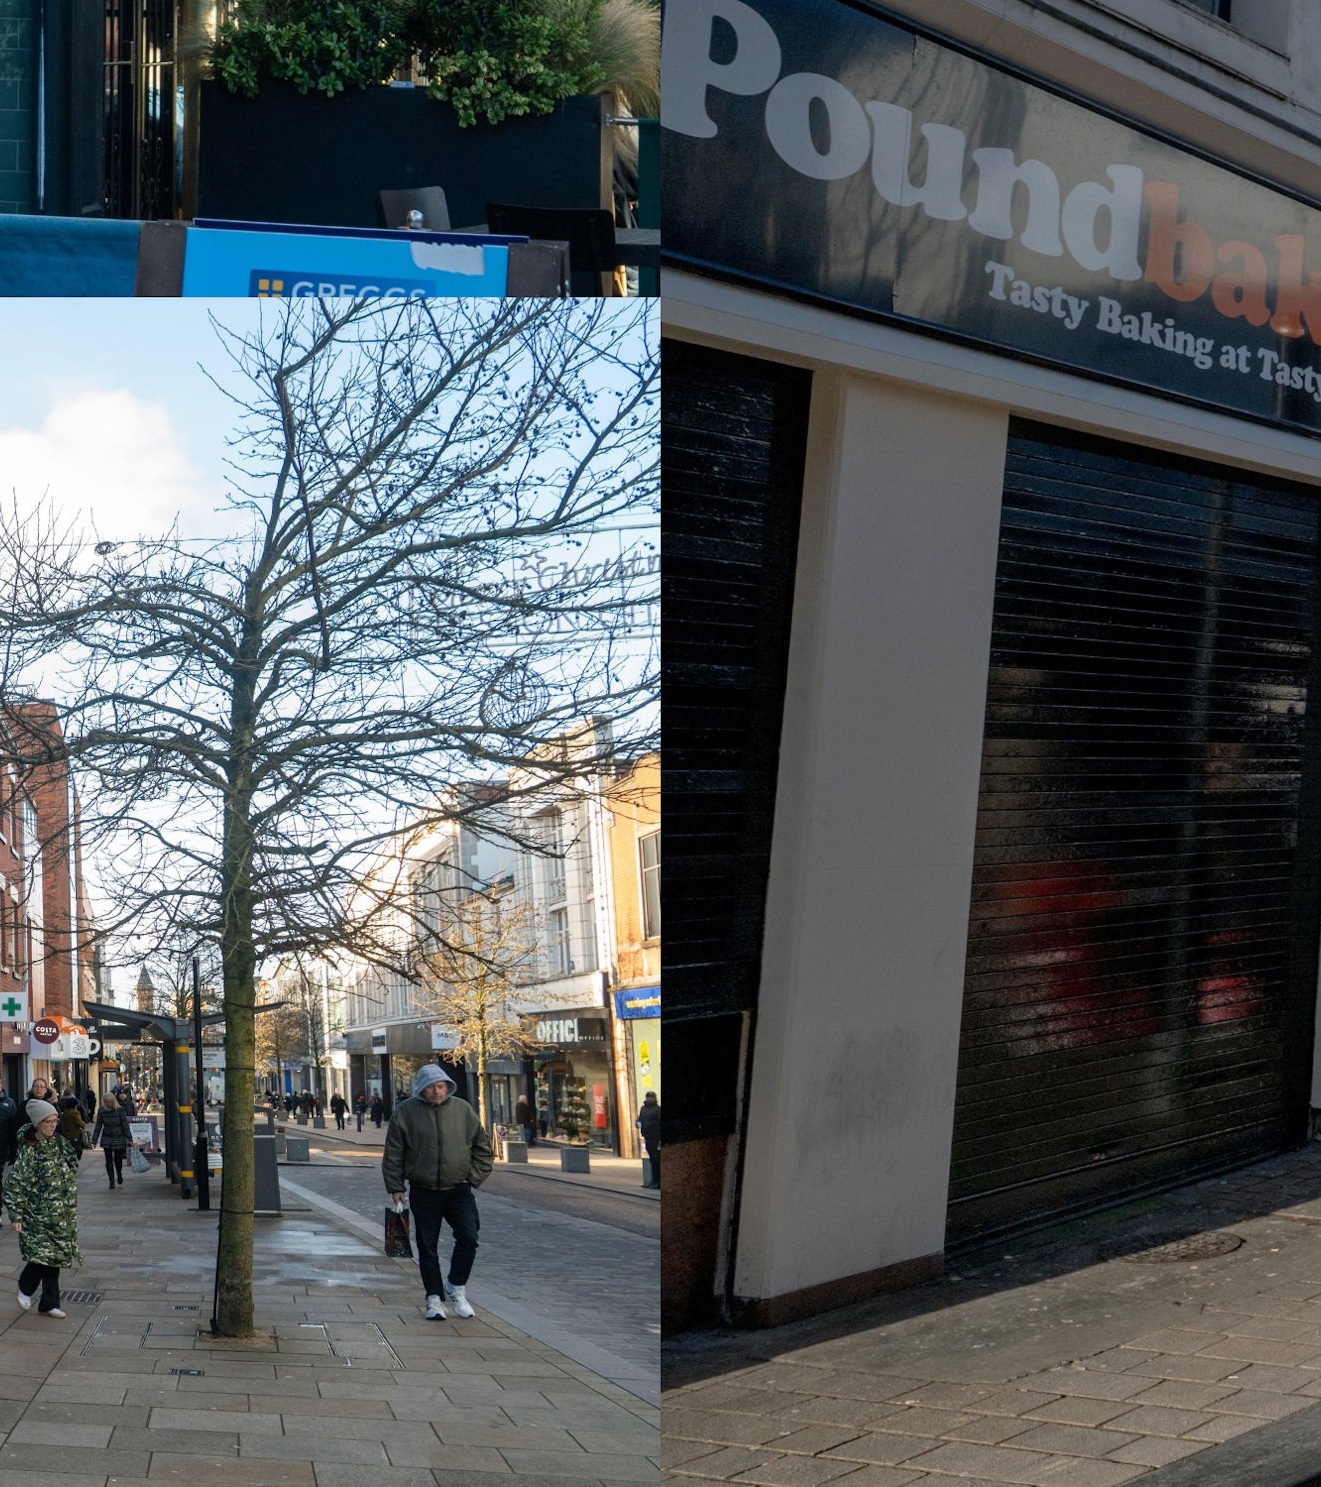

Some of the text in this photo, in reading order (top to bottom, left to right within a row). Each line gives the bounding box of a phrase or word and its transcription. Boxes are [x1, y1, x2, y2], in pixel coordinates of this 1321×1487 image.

[984, 260, 1089, 332] Tasty
[1095, 296, 1214, 369] Baking
[1219, 342, 1250, 375] at
